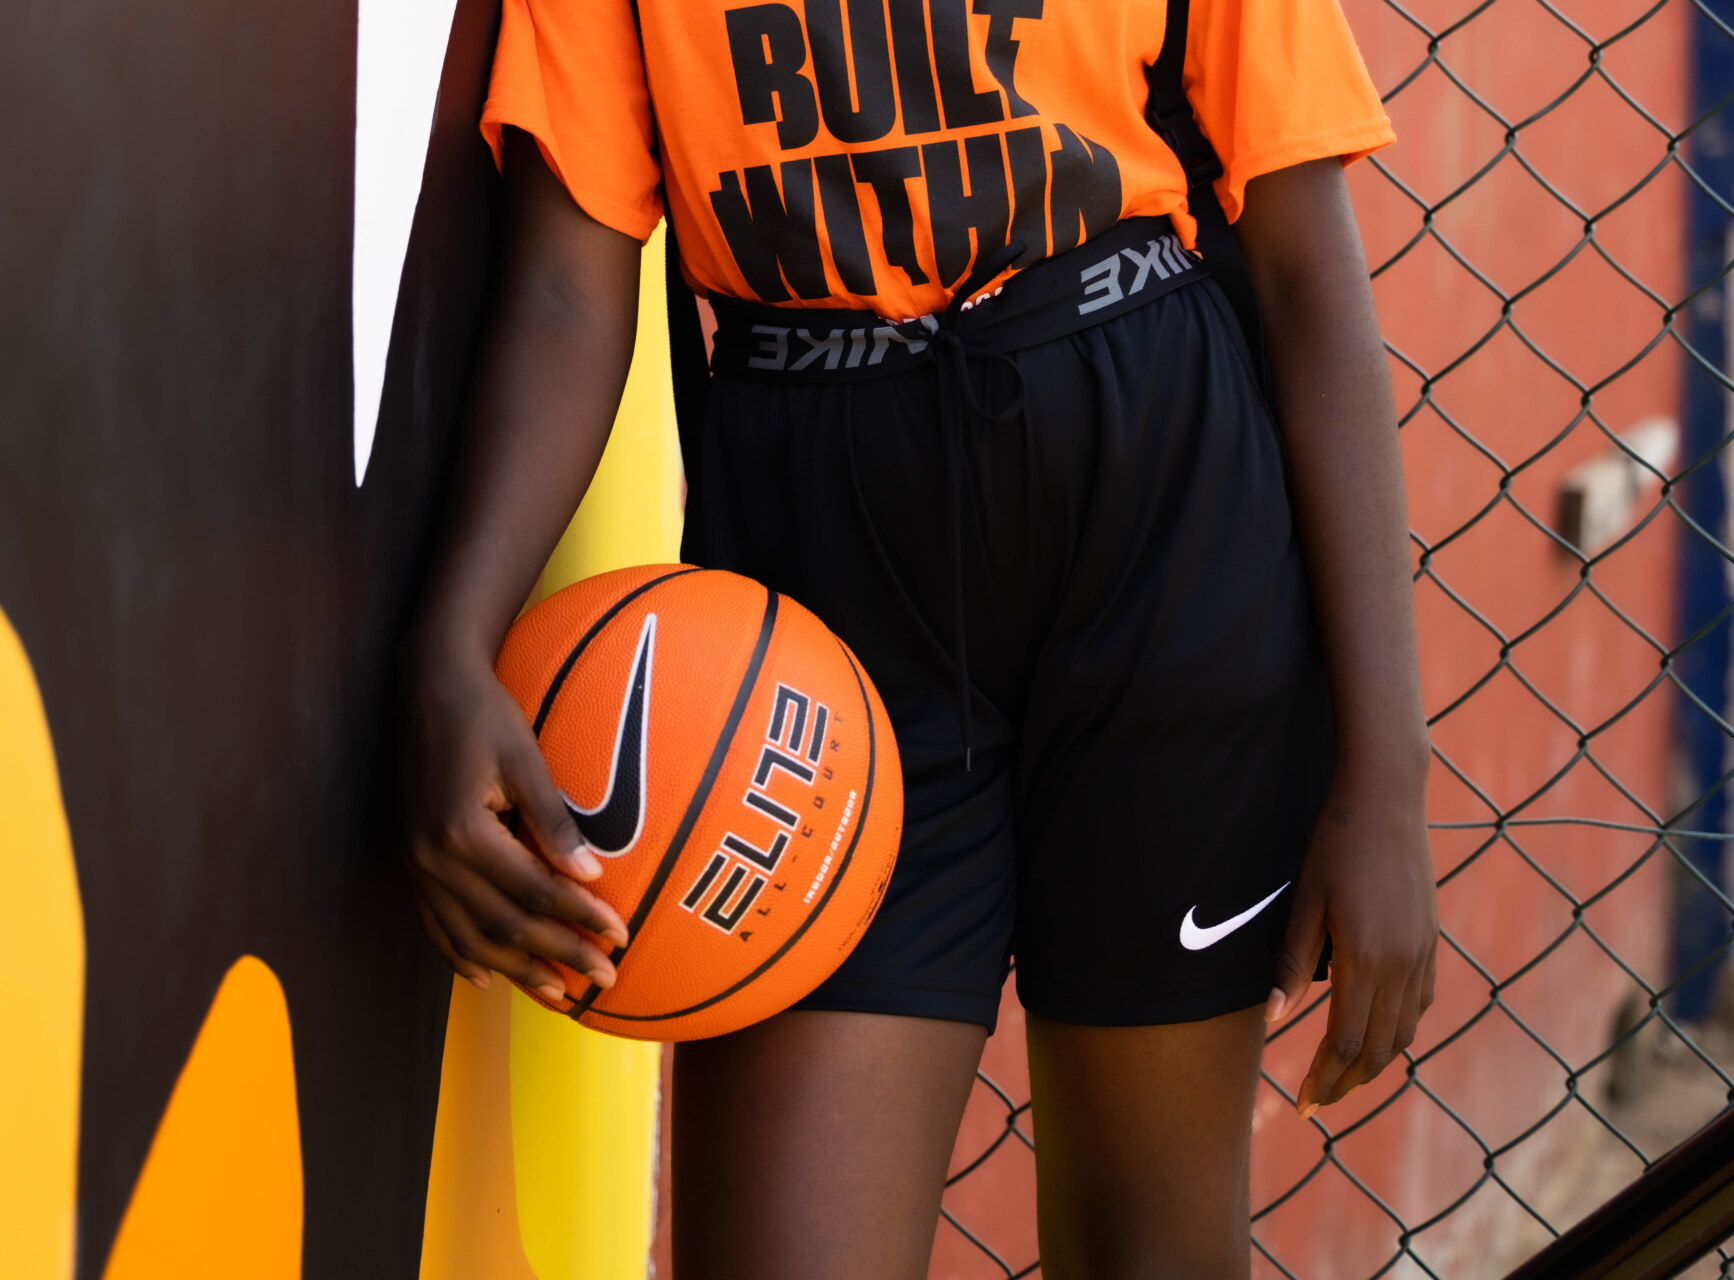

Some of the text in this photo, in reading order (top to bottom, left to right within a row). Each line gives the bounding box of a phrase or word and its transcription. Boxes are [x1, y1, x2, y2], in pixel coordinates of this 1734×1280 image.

[708, 122, 1123, 304] WITHIN
[678, 681, 830, 936] ELITE
[803, 789, 858, 905] INDOOR/OUTDOOR
